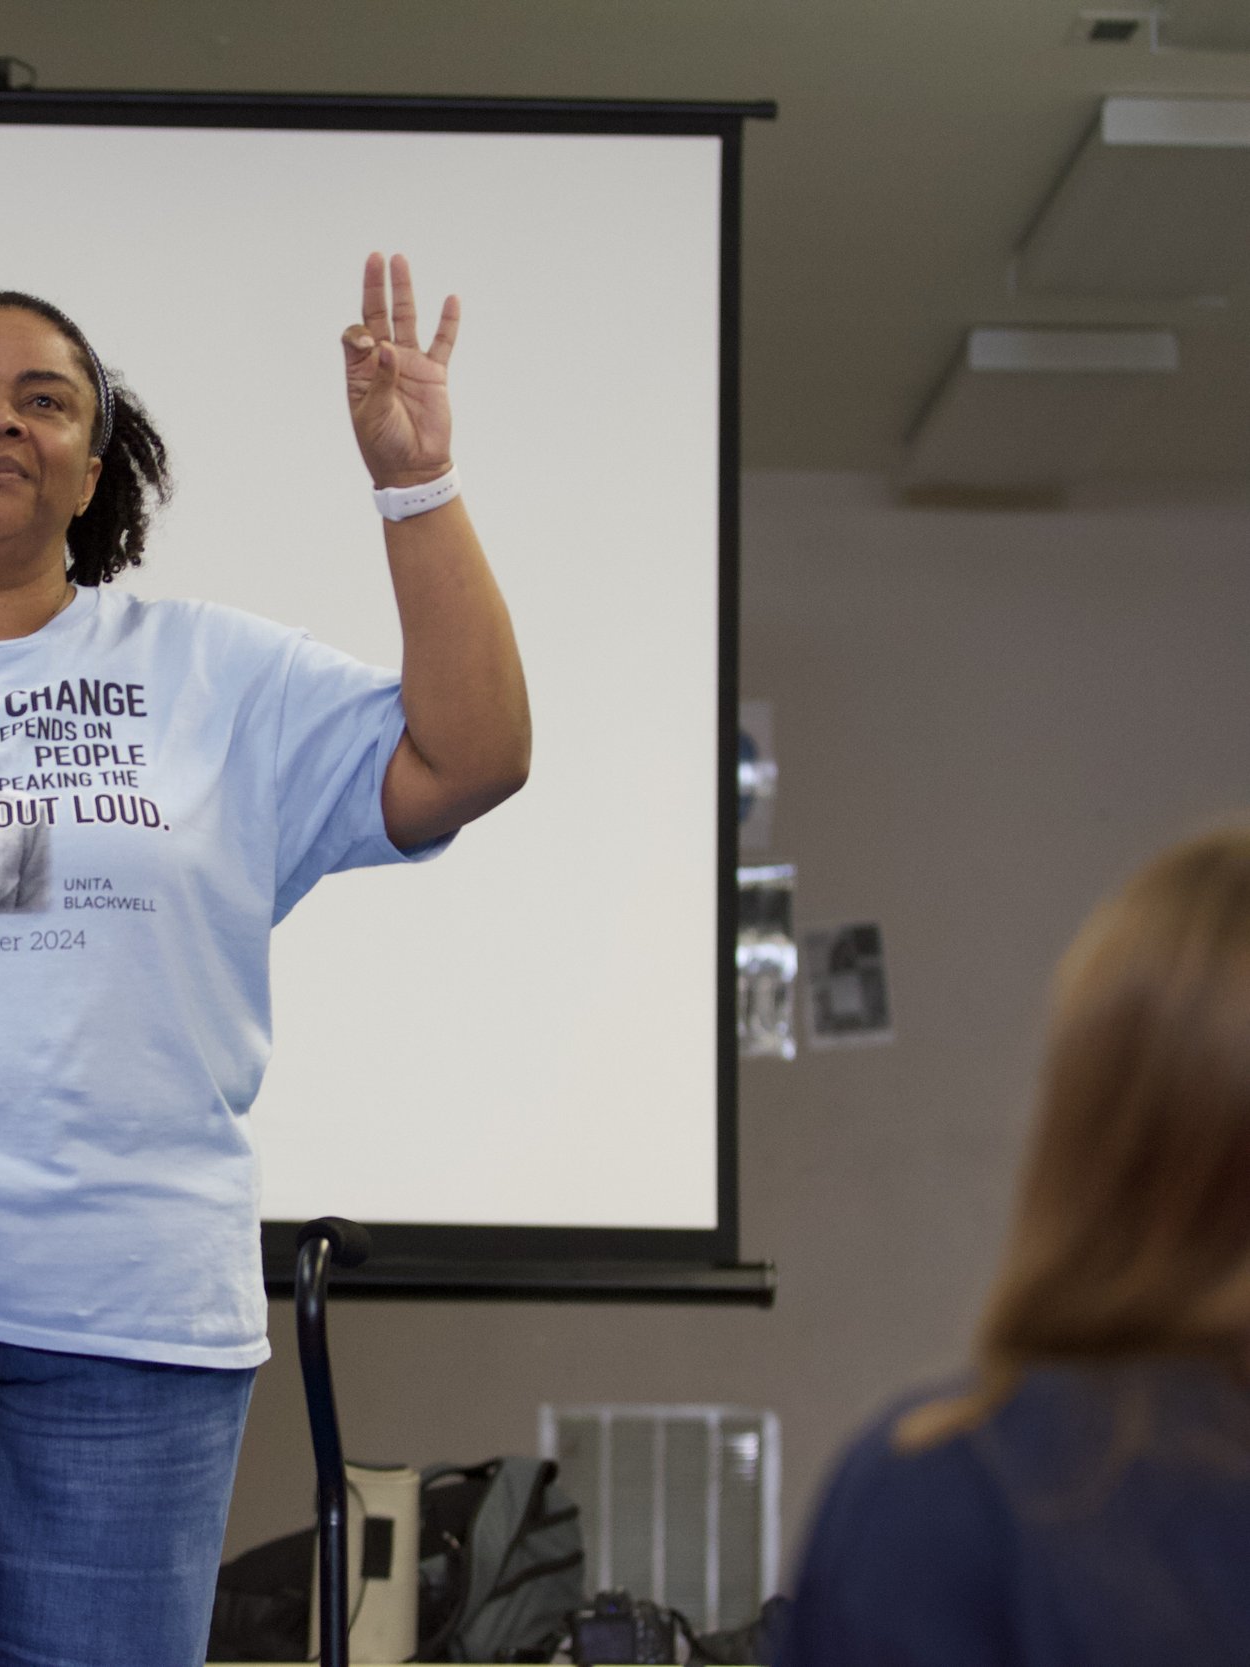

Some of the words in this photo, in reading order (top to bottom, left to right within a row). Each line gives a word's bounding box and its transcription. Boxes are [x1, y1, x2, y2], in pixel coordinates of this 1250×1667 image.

[4, 678, 148, 718] CHANGE
[85, 722, 112, 739] ON
[35, 744, 146, 767] PEOPLE
[99, 770, 138, 788] THE
[75, 794, 171, 831] LOUD.
[64, 878, 112, 891] UNITA
[64, 896, 156, 912] BLACKWELL
[30, 930, 86, 950] 2024
